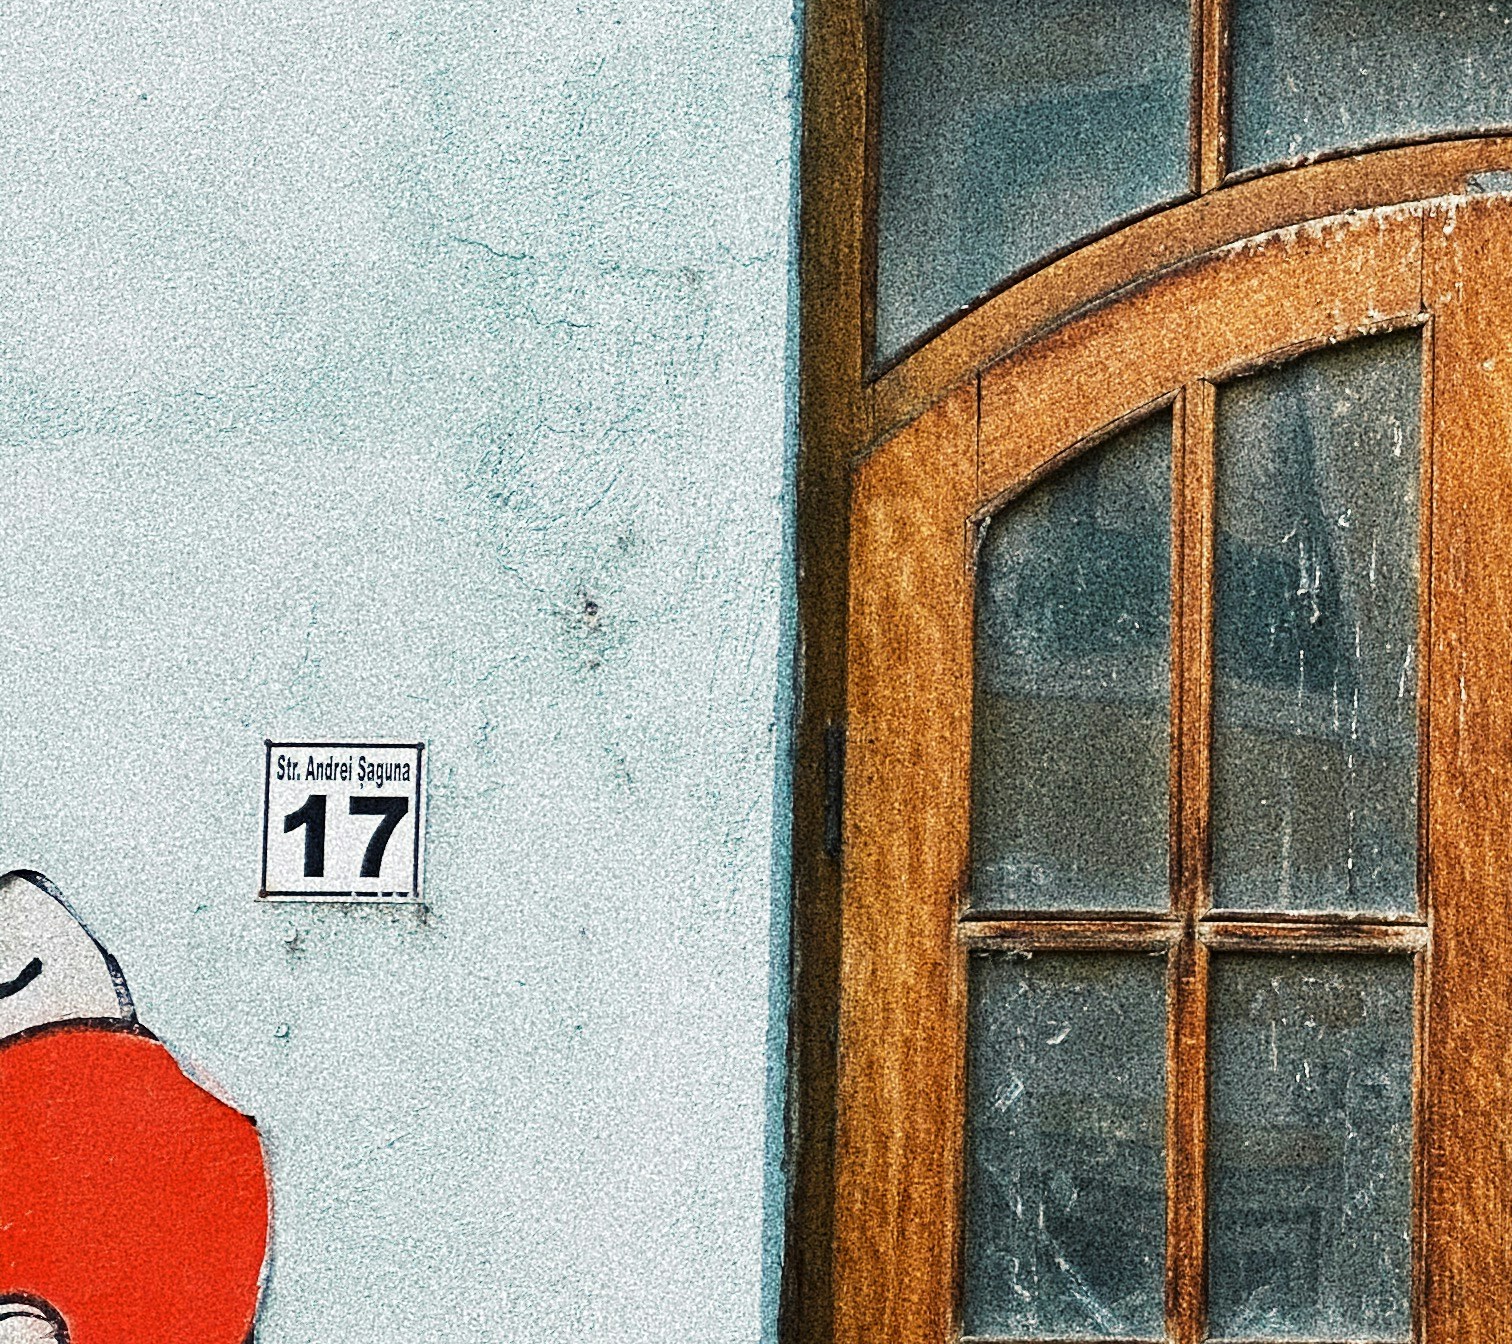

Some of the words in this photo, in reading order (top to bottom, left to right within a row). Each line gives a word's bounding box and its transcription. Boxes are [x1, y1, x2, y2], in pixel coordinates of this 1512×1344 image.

[277, 755, 300, 780] Str.
[306, 755, 352, 780] Andrei
[284, 795, 409, 877] 17
